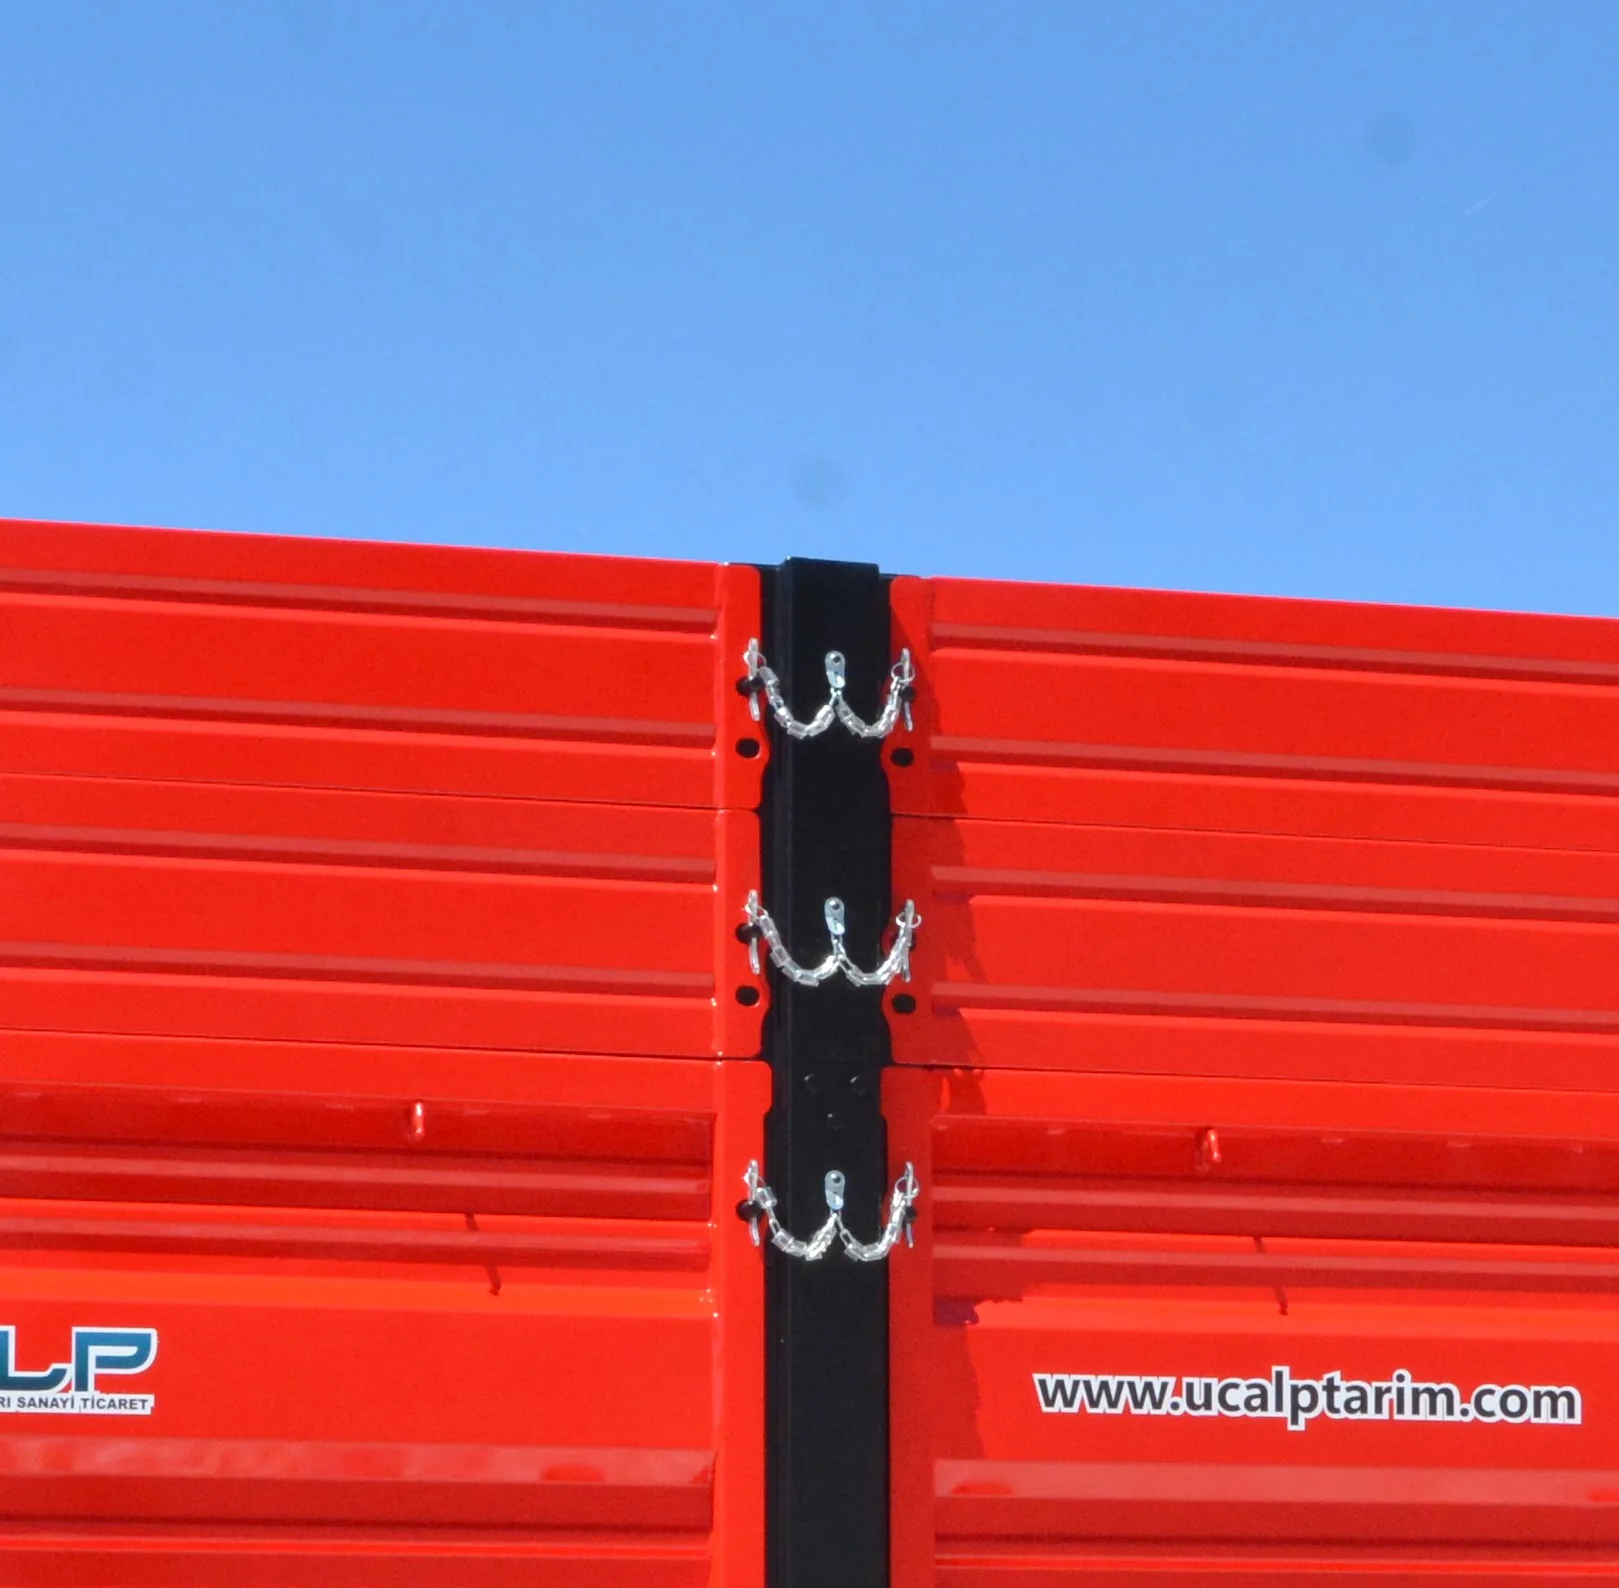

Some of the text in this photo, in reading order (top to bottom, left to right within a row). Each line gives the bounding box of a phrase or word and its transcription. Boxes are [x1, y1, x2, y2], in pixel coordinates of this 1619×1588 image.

[16, 1394, 75, 1409] SANAYİ
[80, 1395, 149, 1411] TİCARET
[1035, 1368, 1579, 1429] www.ucalptarim.com
